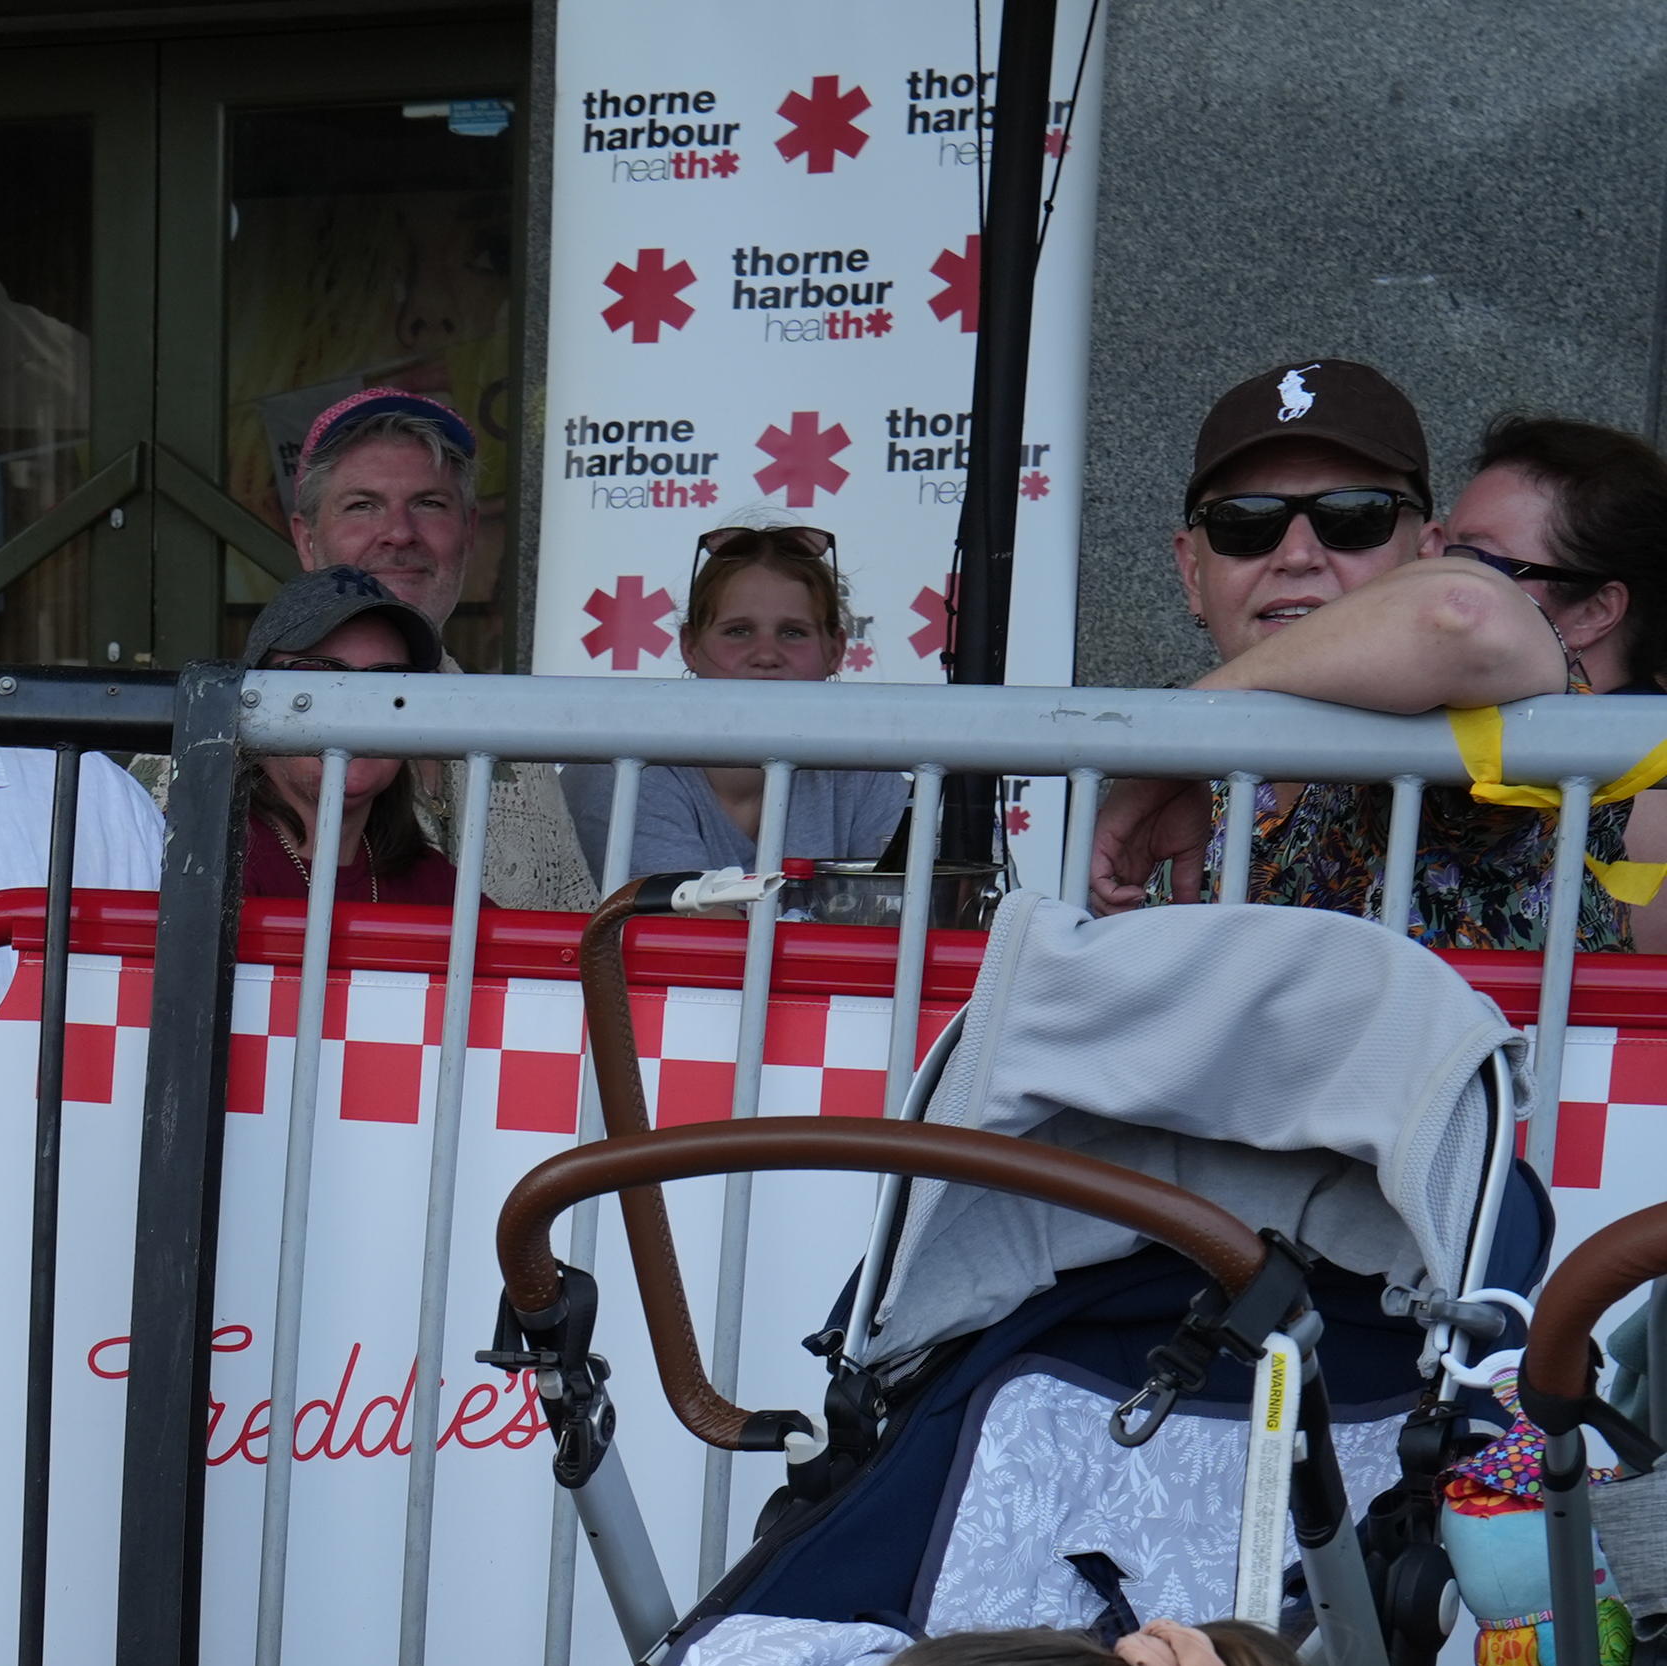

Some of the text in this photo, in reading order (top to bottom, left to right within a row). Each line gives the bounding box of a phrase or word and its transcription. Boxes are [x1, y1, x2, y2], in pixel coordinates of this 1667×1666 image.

[906, 69, 995, 101] thor
[583, 90, 716, 121] thorne
[583, 119, 740, 153] harbour
[612, 150, 710, 182] health
[732, 246, 869, 277] thorne
[732, 278, 893, 310] harbour
[764, 311, 863, 343] health
[564, 415, 695, 447] thorne
[886, 407, 973, 439] thor
[564, 446, 719, 480] harbour
[592, 478, 688, 509] health
[1266, 1367, 1284, 1428] WARNING
